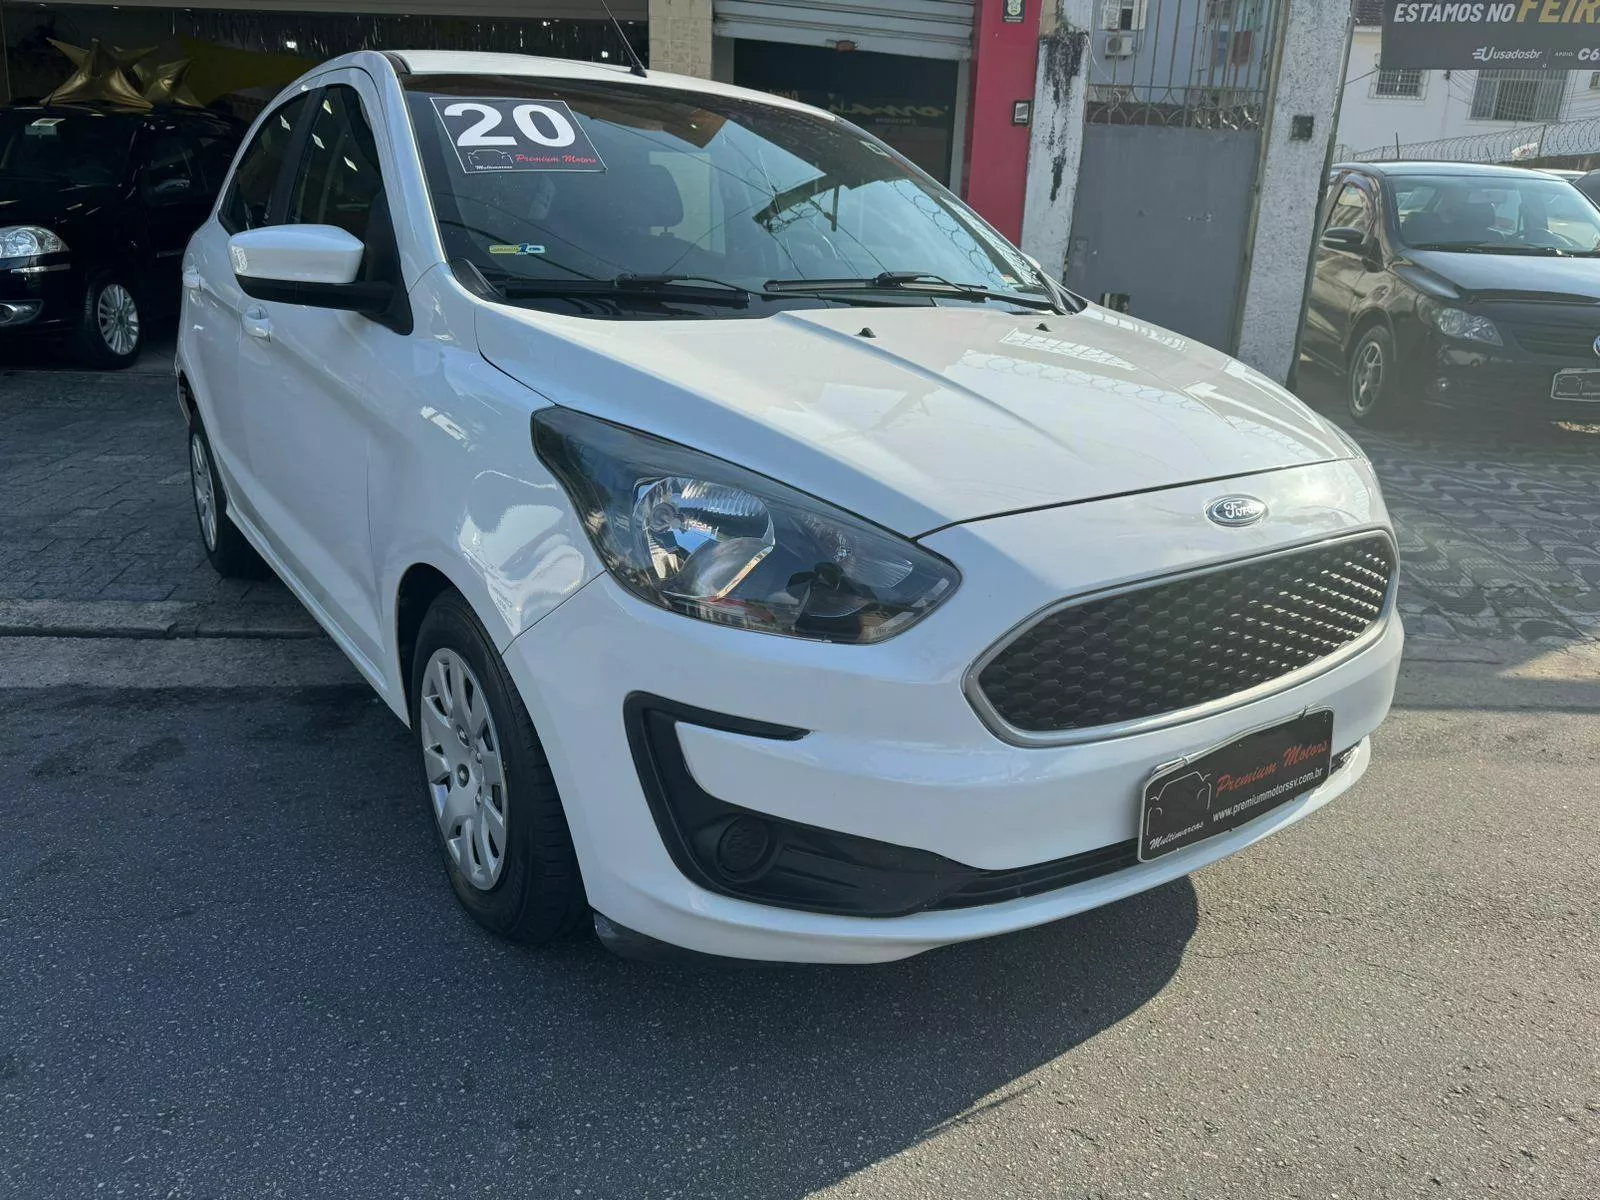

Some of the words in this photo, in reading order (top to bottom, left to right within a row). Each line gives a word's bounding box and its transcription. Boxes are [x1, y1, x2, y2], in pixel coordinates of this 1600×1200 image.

[1394, 3, 1484, 22] ESTAMOS
[1486, 3, 1516, 22] NO
[1515, 0, 1600, 23] FEIR
[444, 102, 576, 147] 20
[515, 154, 560, 163] Premium
[562, 155, 597, 164] Motors
[1216, 762, 1278, 798] Premium
[1283, 740, 1330, 769] Motors
[1212, 767, 1323, 822] www.premiummotorssv.com.br
